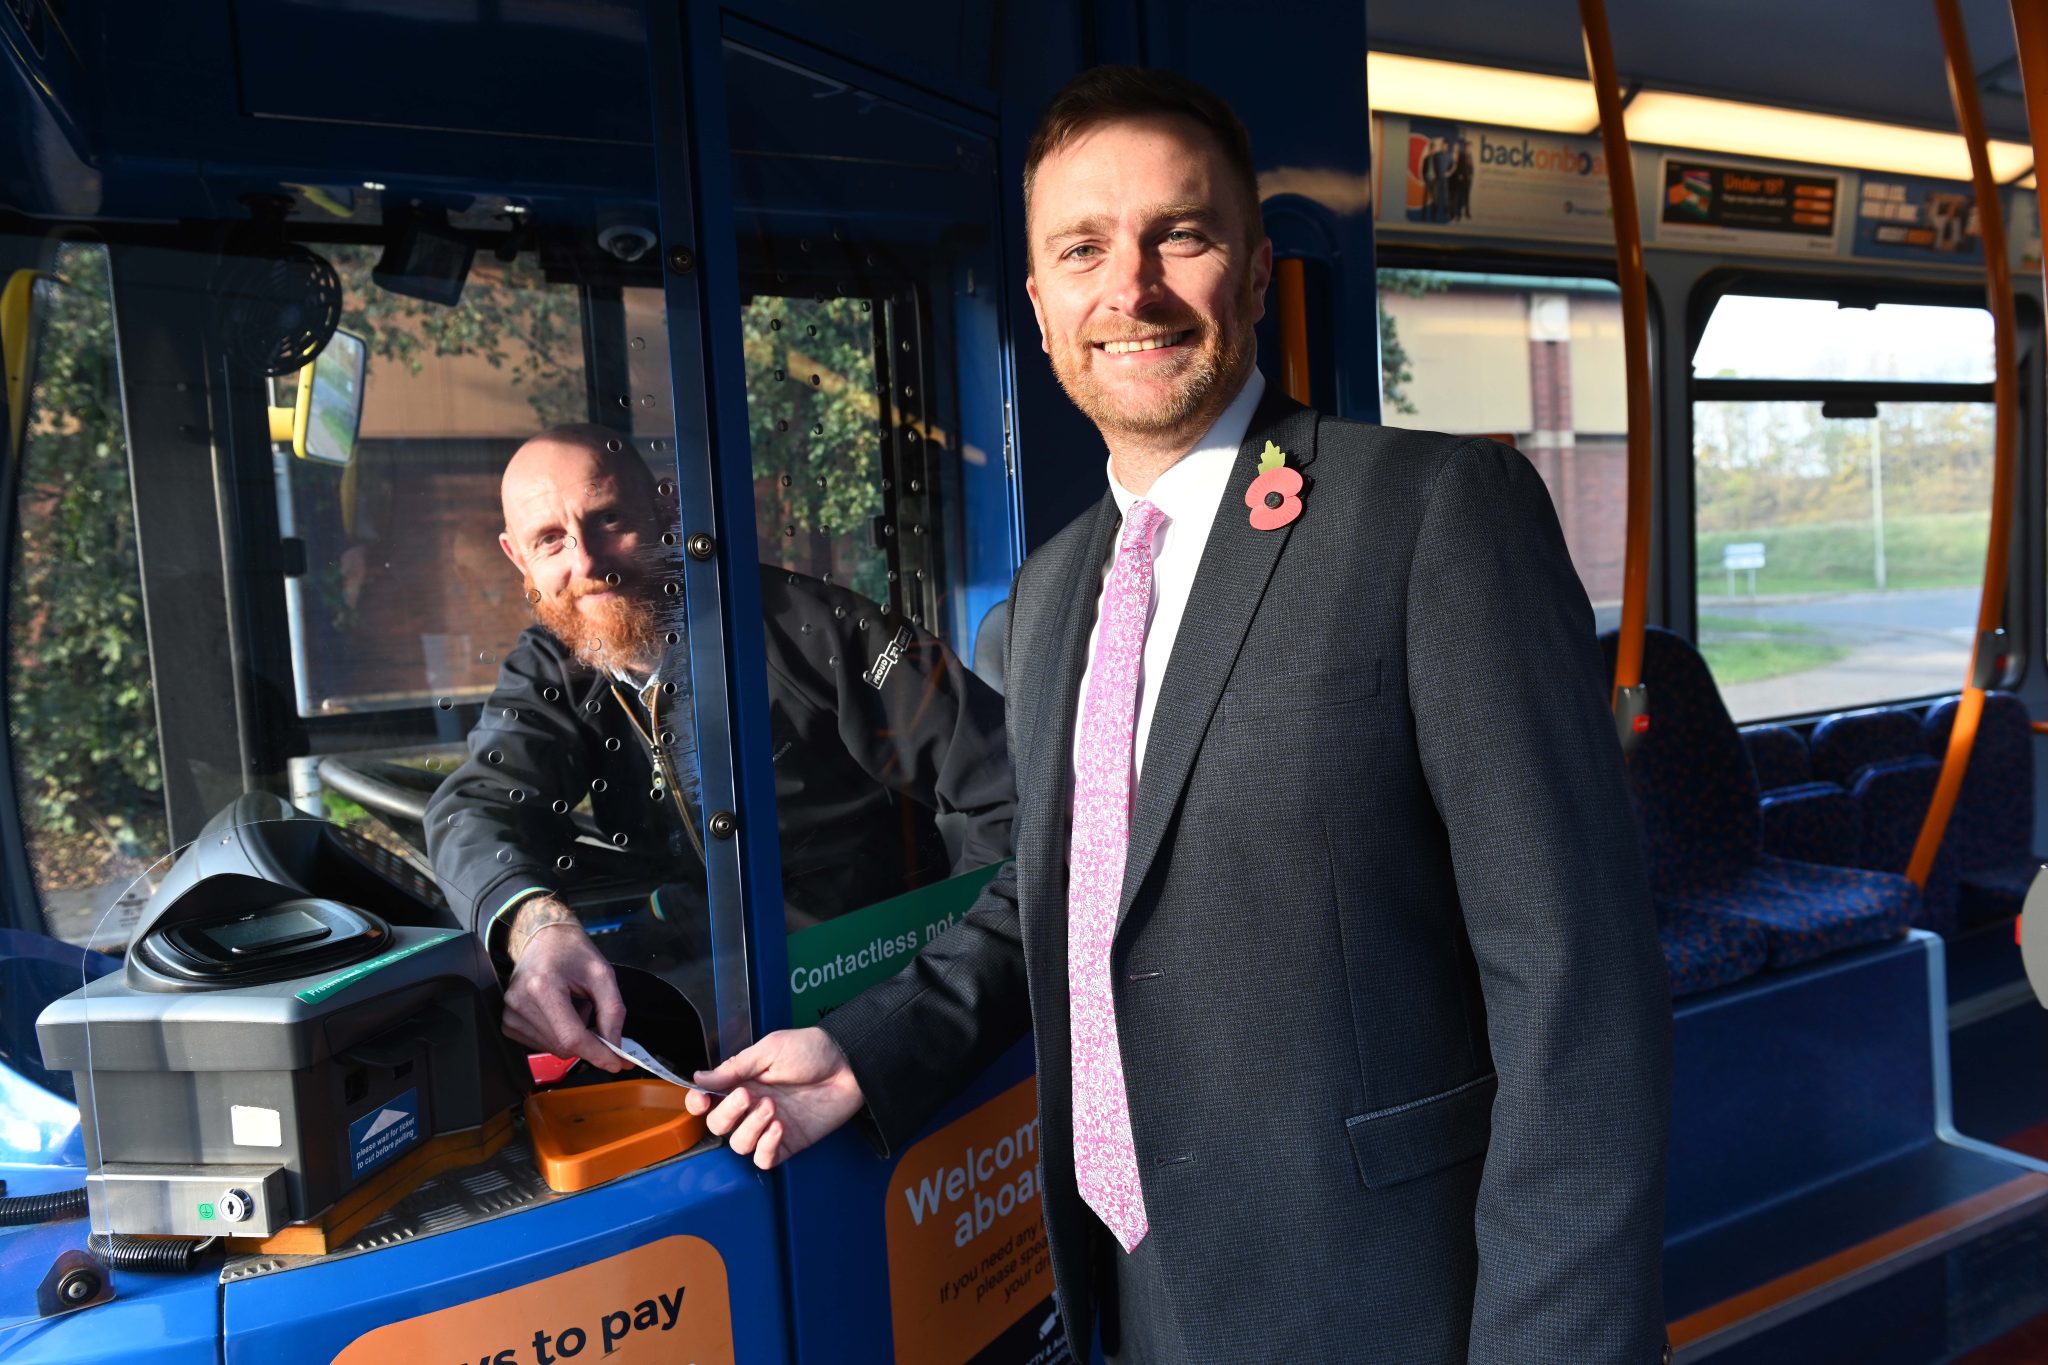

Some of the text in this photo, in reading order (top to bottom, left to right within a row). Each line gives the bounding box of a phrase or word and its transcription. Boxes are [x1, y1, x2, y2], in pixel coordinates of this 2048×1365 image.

[1480, 134, 1608, 176] backonboa
[872, 659, 888, 685] PROUD
[790, 911, 955, 994] Contactless not
[356, 1117, 415, 1161] please wait for ticket
[357, 1129, 414, 1171] to cut before pulling
[905, 1117, 1040, 1226] Welcom
[940, 1282, 949, 1304] If
[953, 1266, 978, 1299] you
[981, 1235, 1013, 1273] need
[1016, 1223, 1037, 1247] any
[976, 1236, 1048, 1303] please spea
[1004, 1269, 1031, 1304] your
[532, 1286, 686, 1365] to pay
